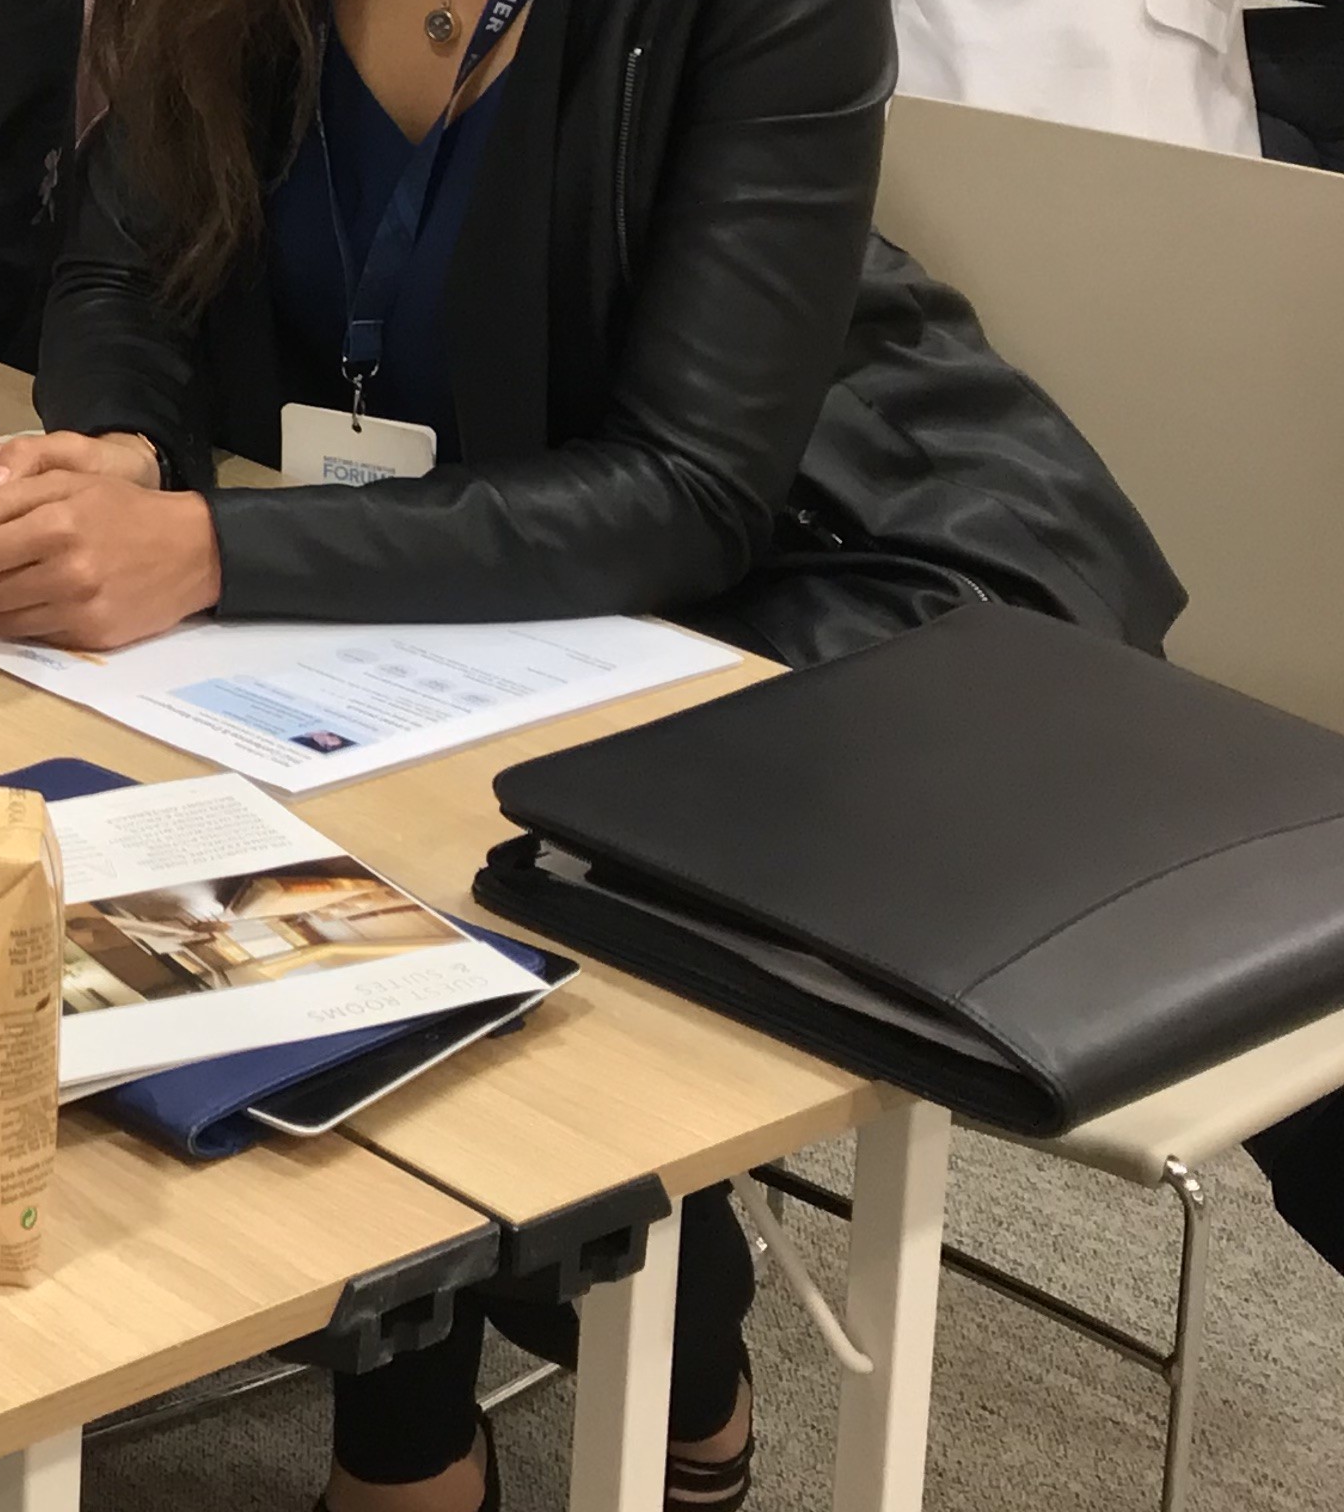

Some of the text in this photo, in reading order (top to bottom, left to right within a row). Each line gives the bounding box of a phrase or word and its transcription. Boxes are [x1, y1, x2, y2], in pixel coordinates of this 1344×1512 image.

[305, 975, 489, 1024] GUEST ROOMS
[354, 962, 471, 997] & SUITES
